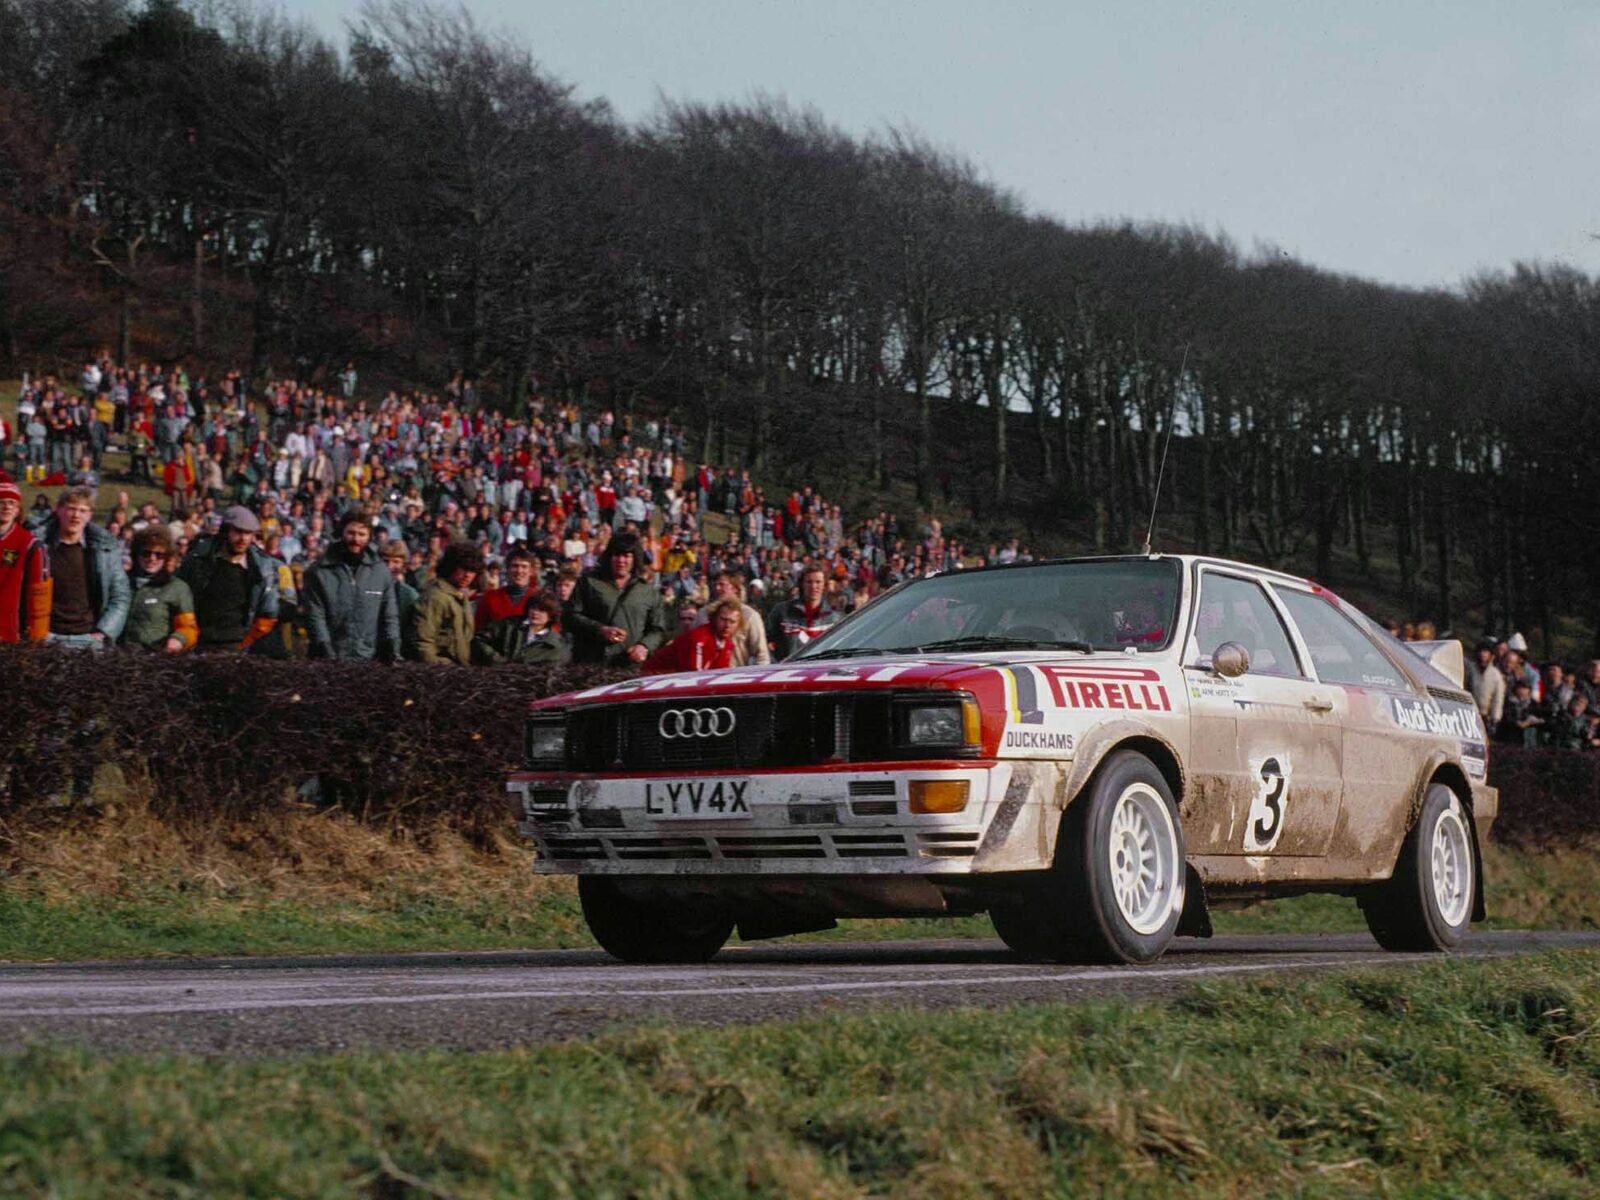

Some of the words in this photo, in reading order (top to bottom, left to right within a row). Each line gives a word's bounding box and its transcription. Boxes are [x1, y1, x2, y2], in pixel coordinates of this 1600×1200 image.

[1036, 665, 1172, 711] PIRELLI
[1395, 698, 1428, 731] Audi
[1423, 702, 1462, 737] Sport
[1458, 708, 1482, 739] UK
[1006, 731, 1073, 750] DUCKHAMS
[646, 781, 749, 814] LYV4X
[1254, 757, 1285, 846] 3
